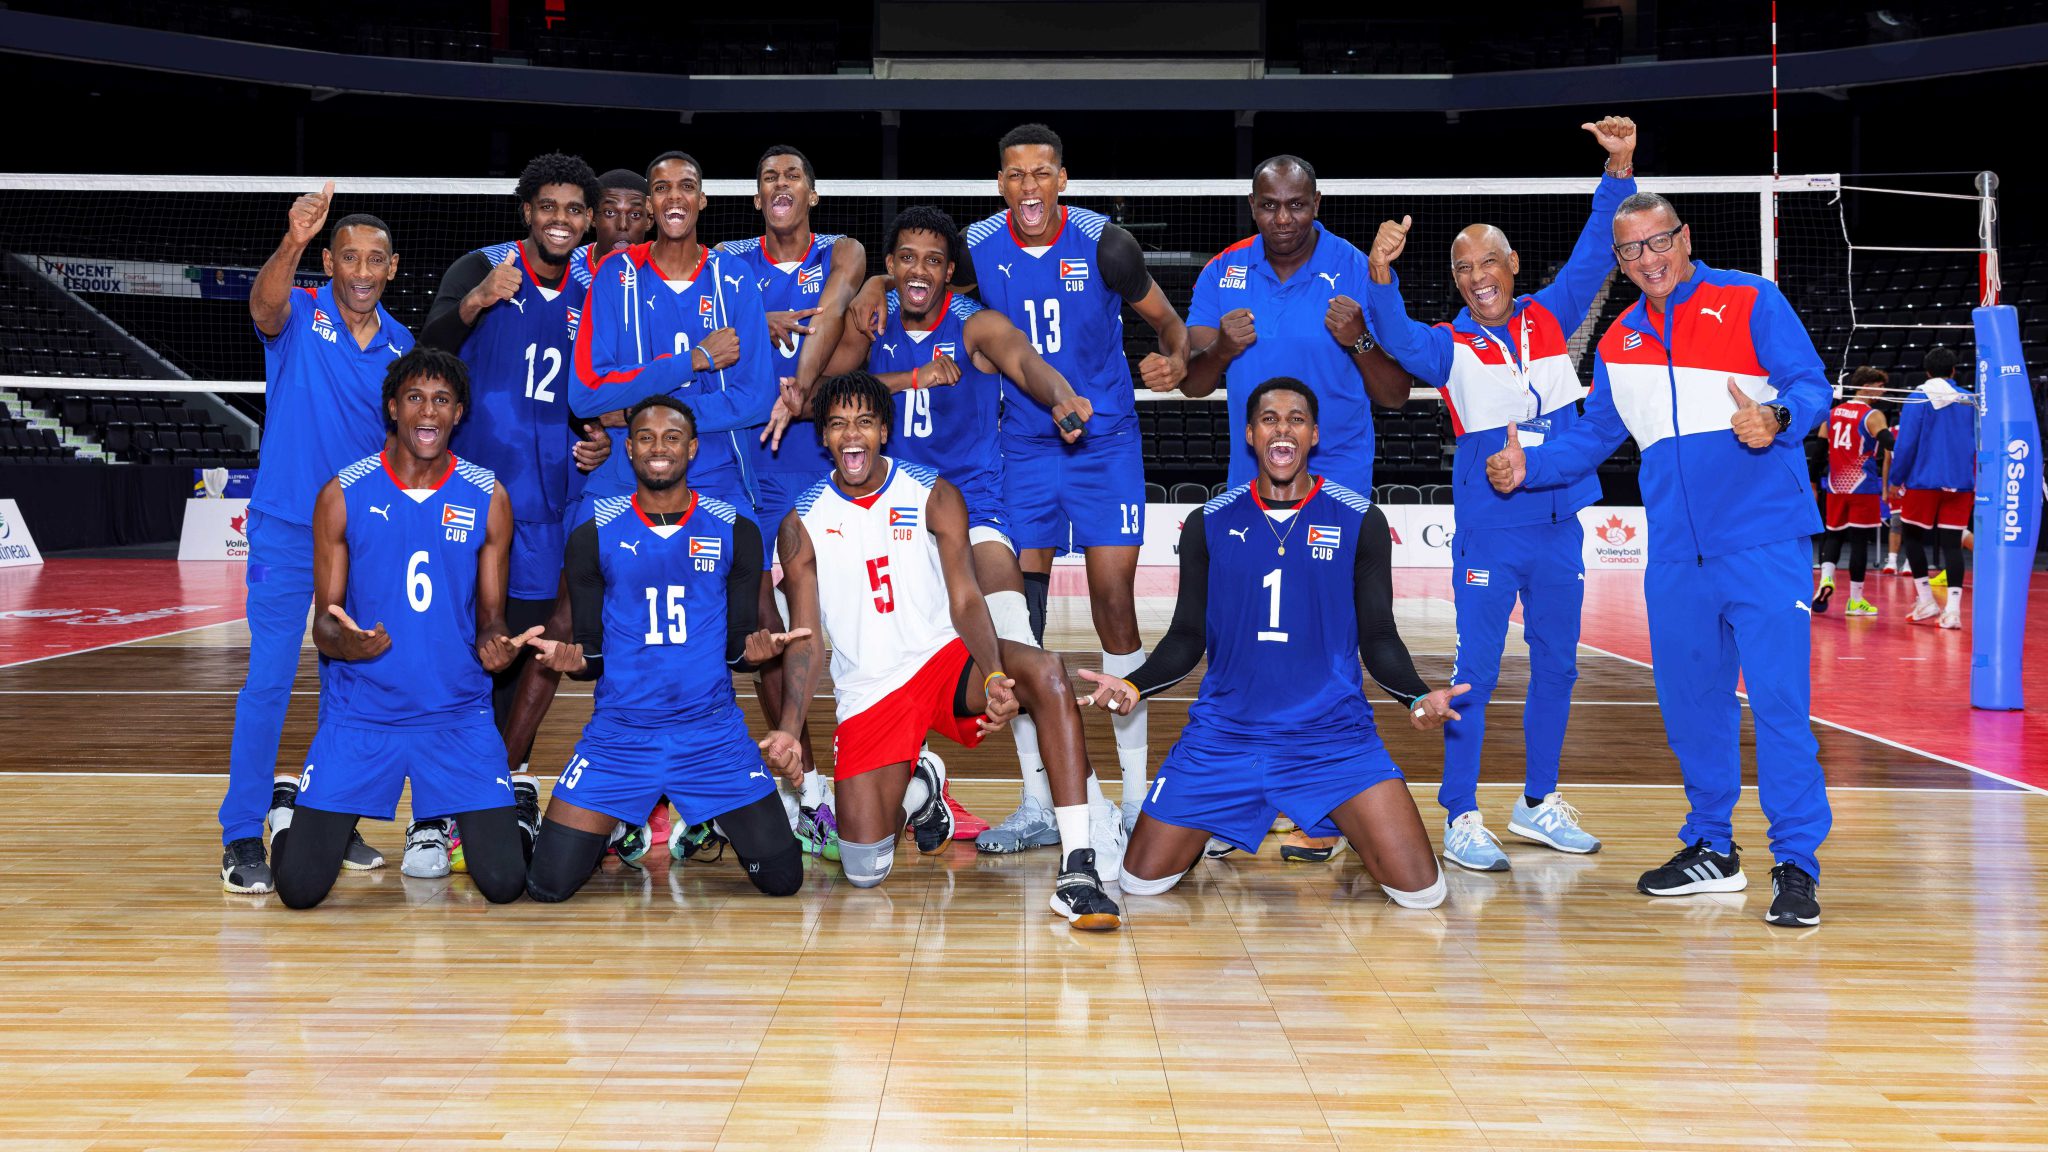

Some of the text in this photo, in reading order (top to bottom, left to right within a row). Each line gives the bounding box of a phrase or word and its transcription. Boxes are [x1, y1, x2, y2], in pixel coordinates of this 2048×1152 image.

[63, 278, 121, 293] LEDOUX
[802, 282, 820, 295] CUB
[1065, 280, 1085, 292] CUB
[1219, 277, 1247, 290] CUBA
[1024, 298, 1062, 354] 13
[525, 343, 562, 403] 12
[1980, 373, 1988, 417] Senoh
[902, 387, 933, 438] 19
[1832, 421, 1852, 451] 14
[2004, 462, 2026, 542] Senoh
[1120, 503, 1139, 534] 13
[225, 540, 249, 548] Volle
[445, 527, 468, 543] CUB
[893, 528, 913, 541] CUB
[227, 548, 248, 557] Can
[694, 558, 715, 572] CUB
[1311, 546, 1334, 561] CUB
[1596, 548, 1641, 557] Volleyball
[406, 550, 433, 613] 6
[865, 555, 895, 615] 5
[644, 585, 688, 645] 15
[1257, 568, 1289, 643] 1
[300, 764, 315, 793] 6
[558, 753, 590, 790] 15
[1151, 776, 1167, 804] 1
